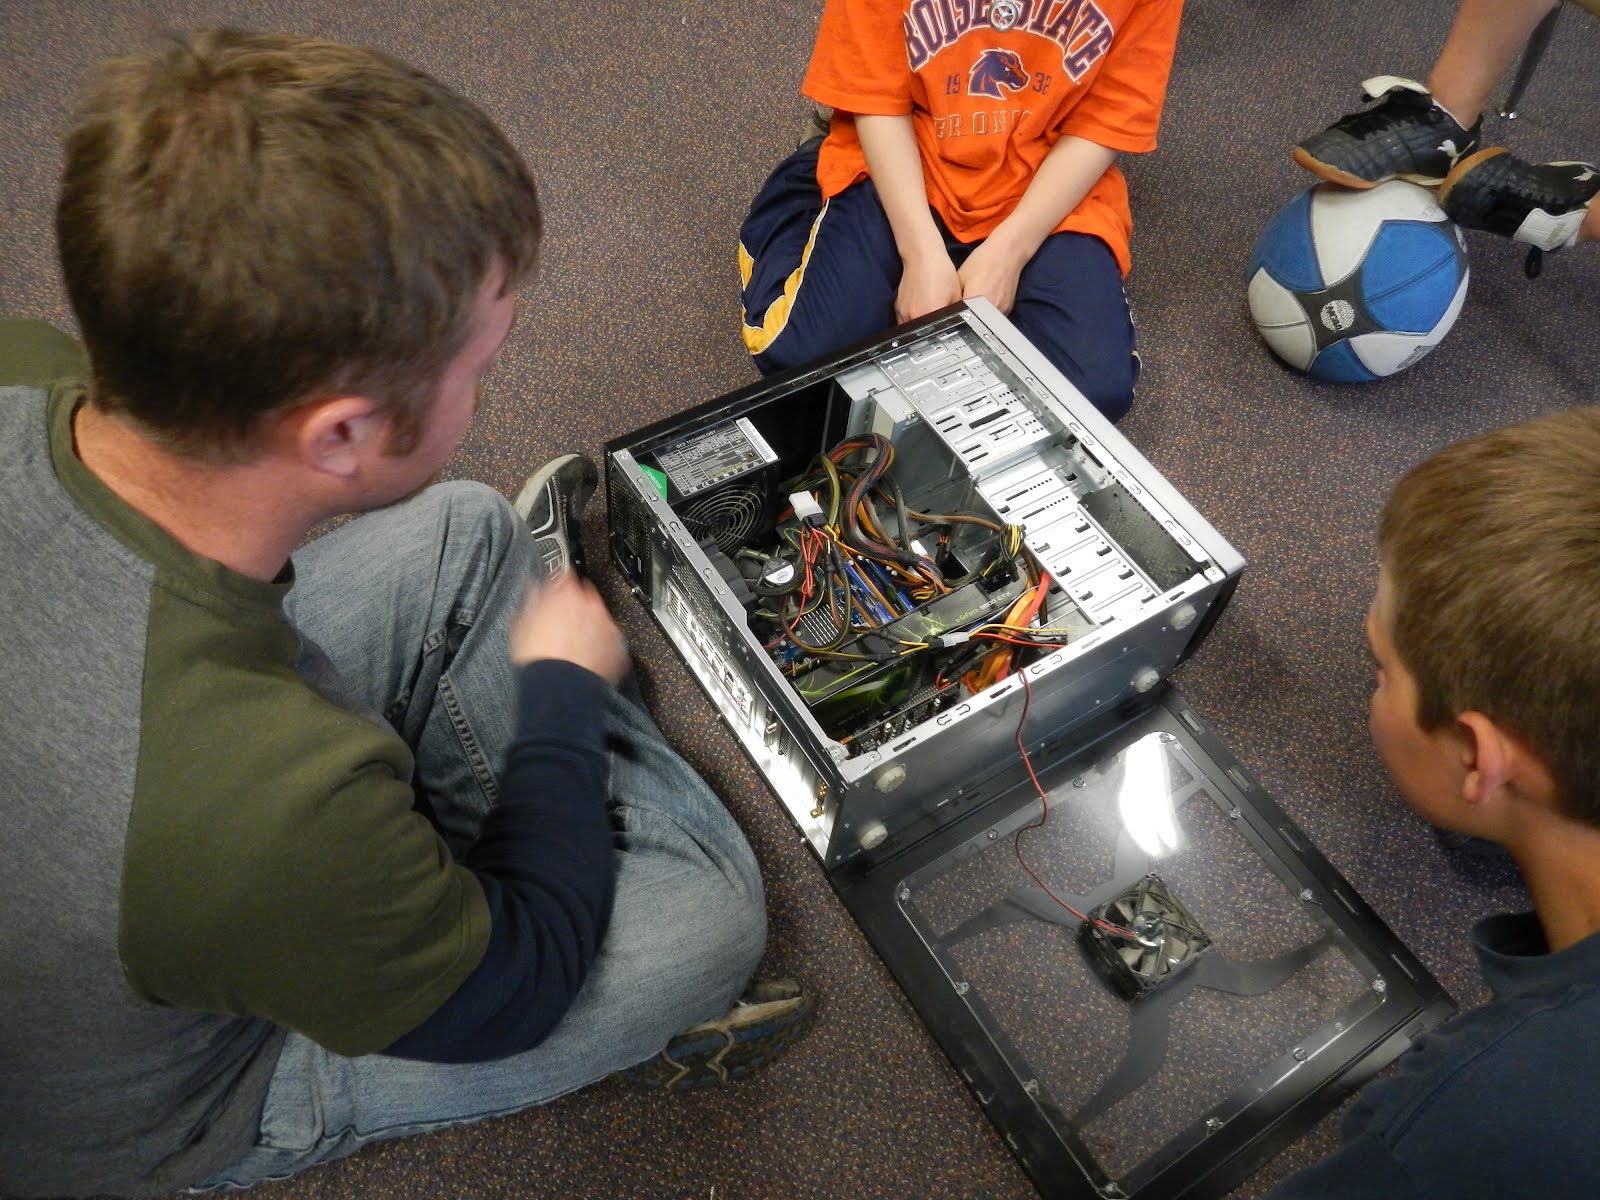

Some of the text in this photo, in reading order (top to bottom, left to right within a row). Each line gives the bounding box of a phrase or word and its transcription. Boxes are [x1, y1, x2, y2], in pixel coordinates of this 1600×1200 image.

[945, 72, 1052, 96] 19 32
[997, 591, 1011, 601] GTX
